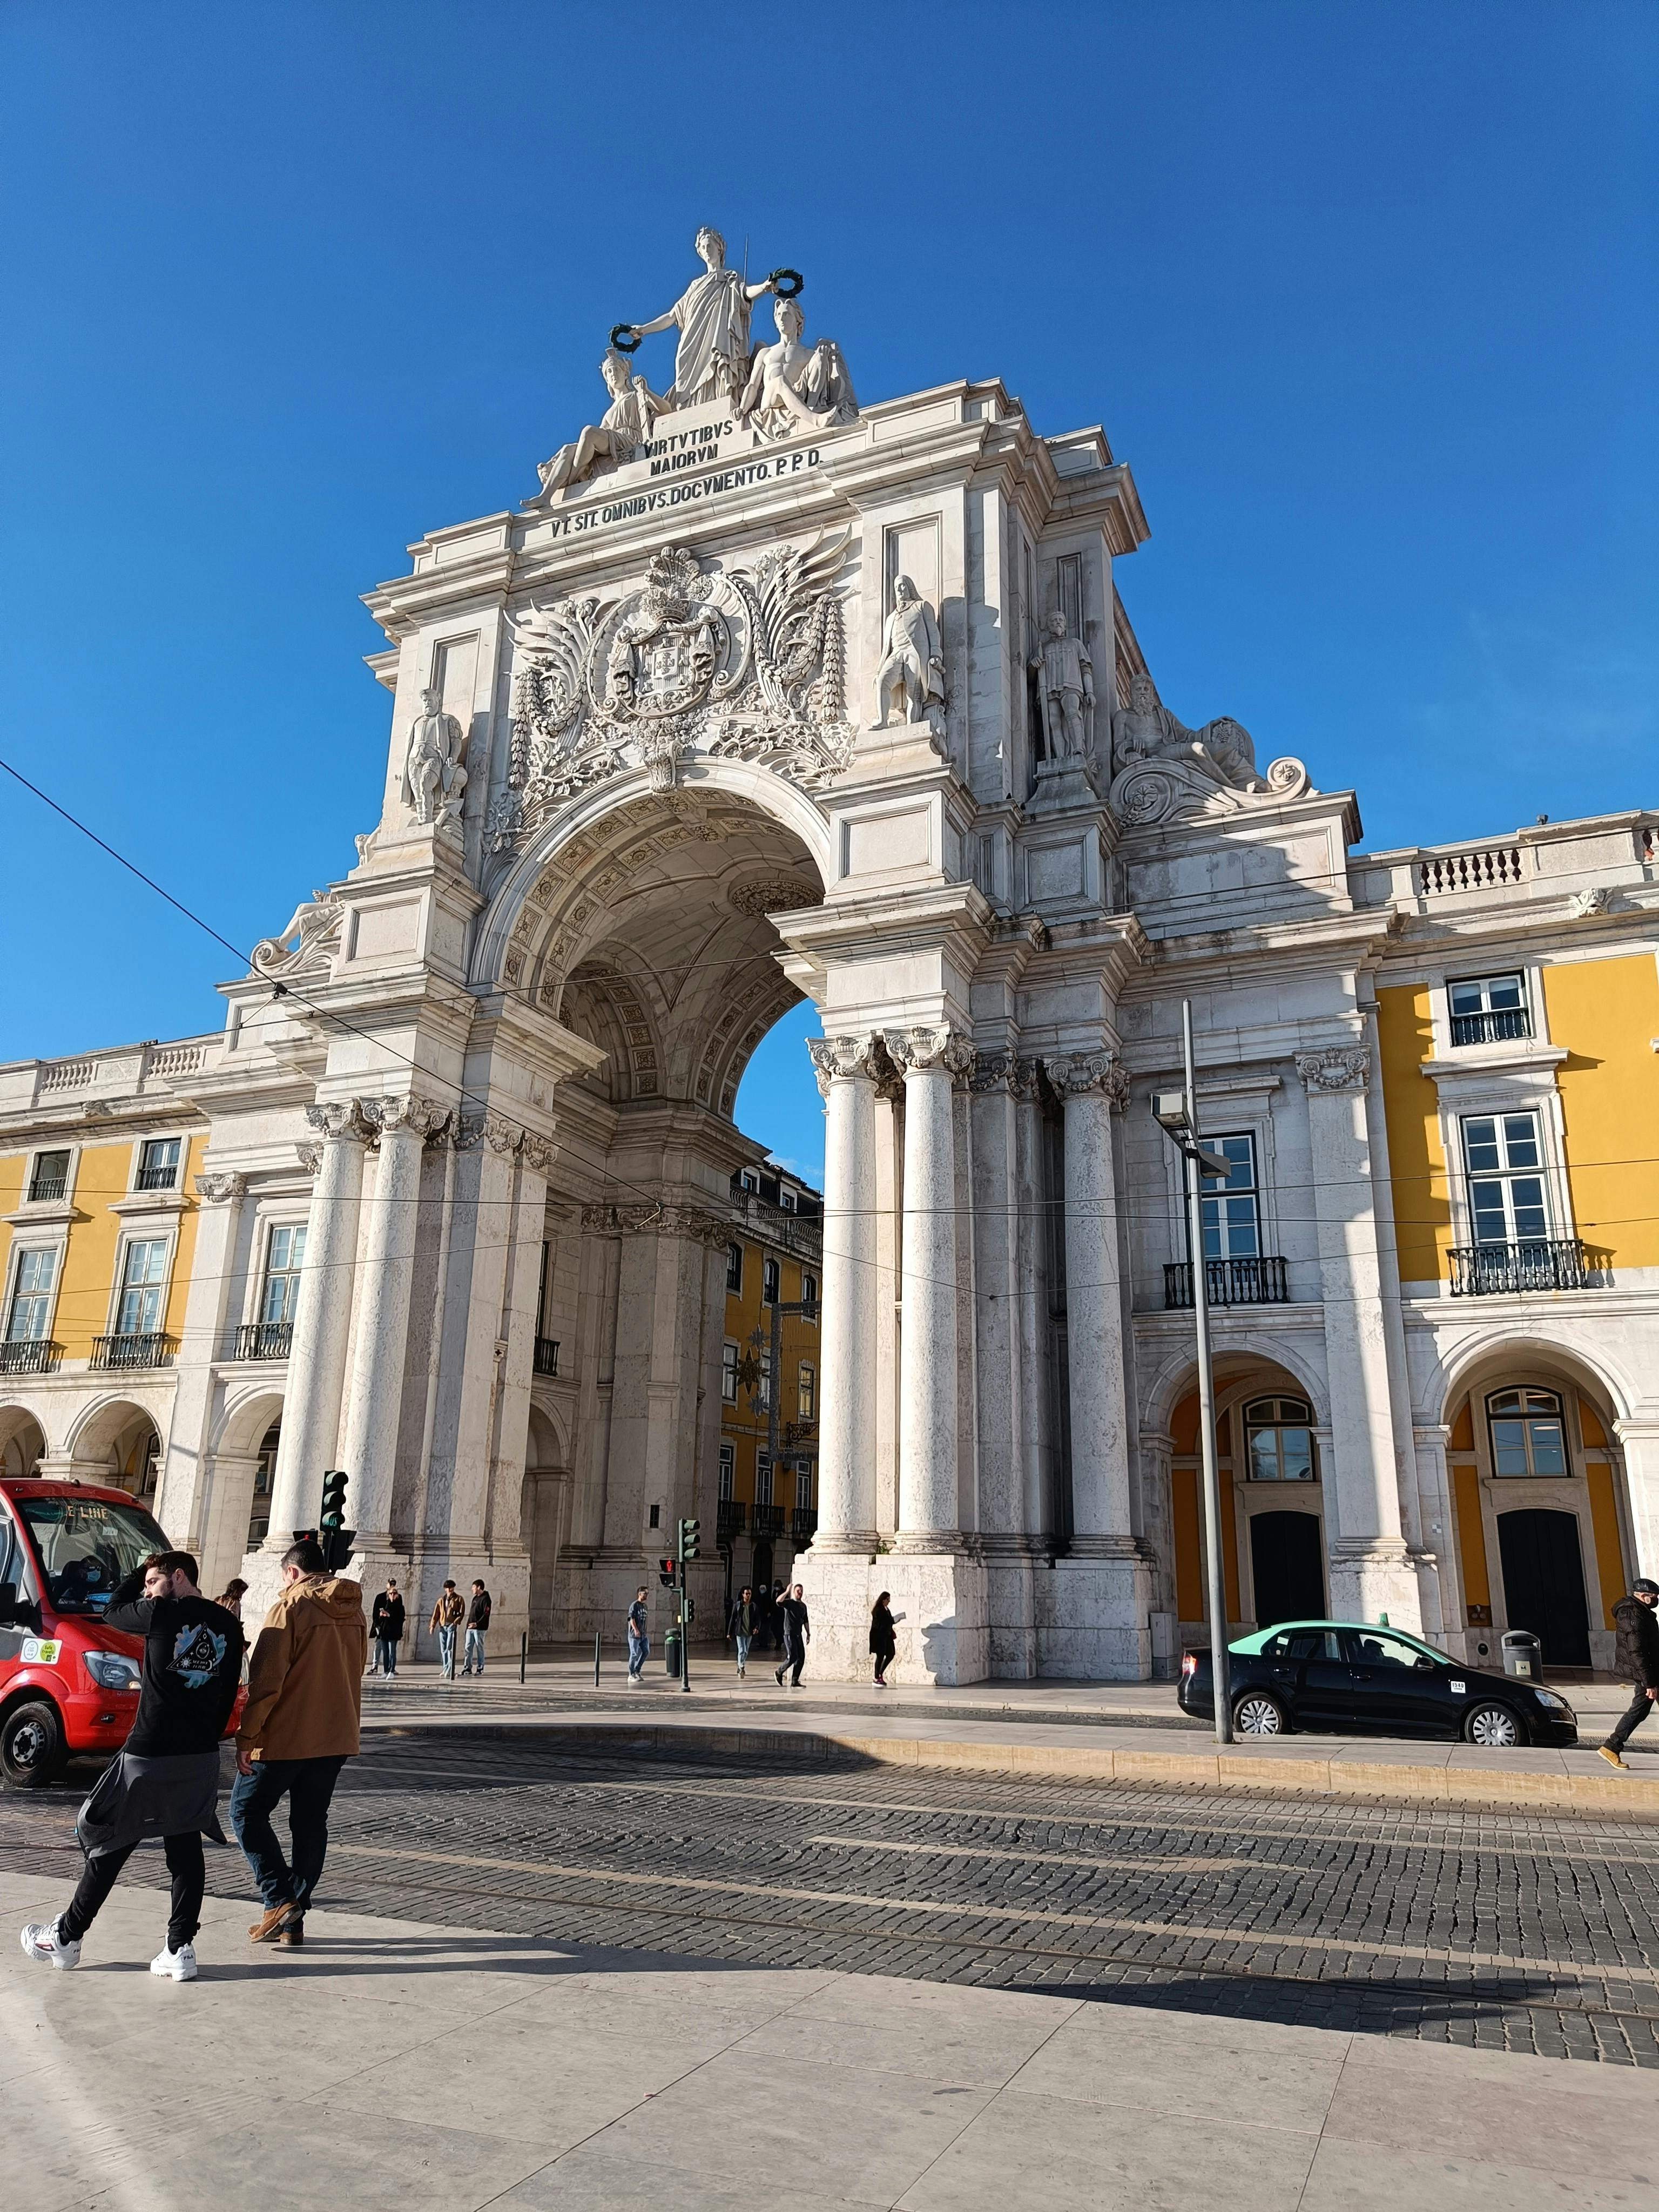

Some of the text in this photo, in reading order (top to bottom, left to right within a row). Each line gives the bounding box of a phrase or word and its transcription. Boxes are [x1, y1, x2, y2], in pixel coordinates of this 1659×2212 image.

[644, 420, 733, 458] VIRTVTIBVS
[650, 443, 718, 476] MAIORVM
[80, 1506, 109, 1520] LINE
